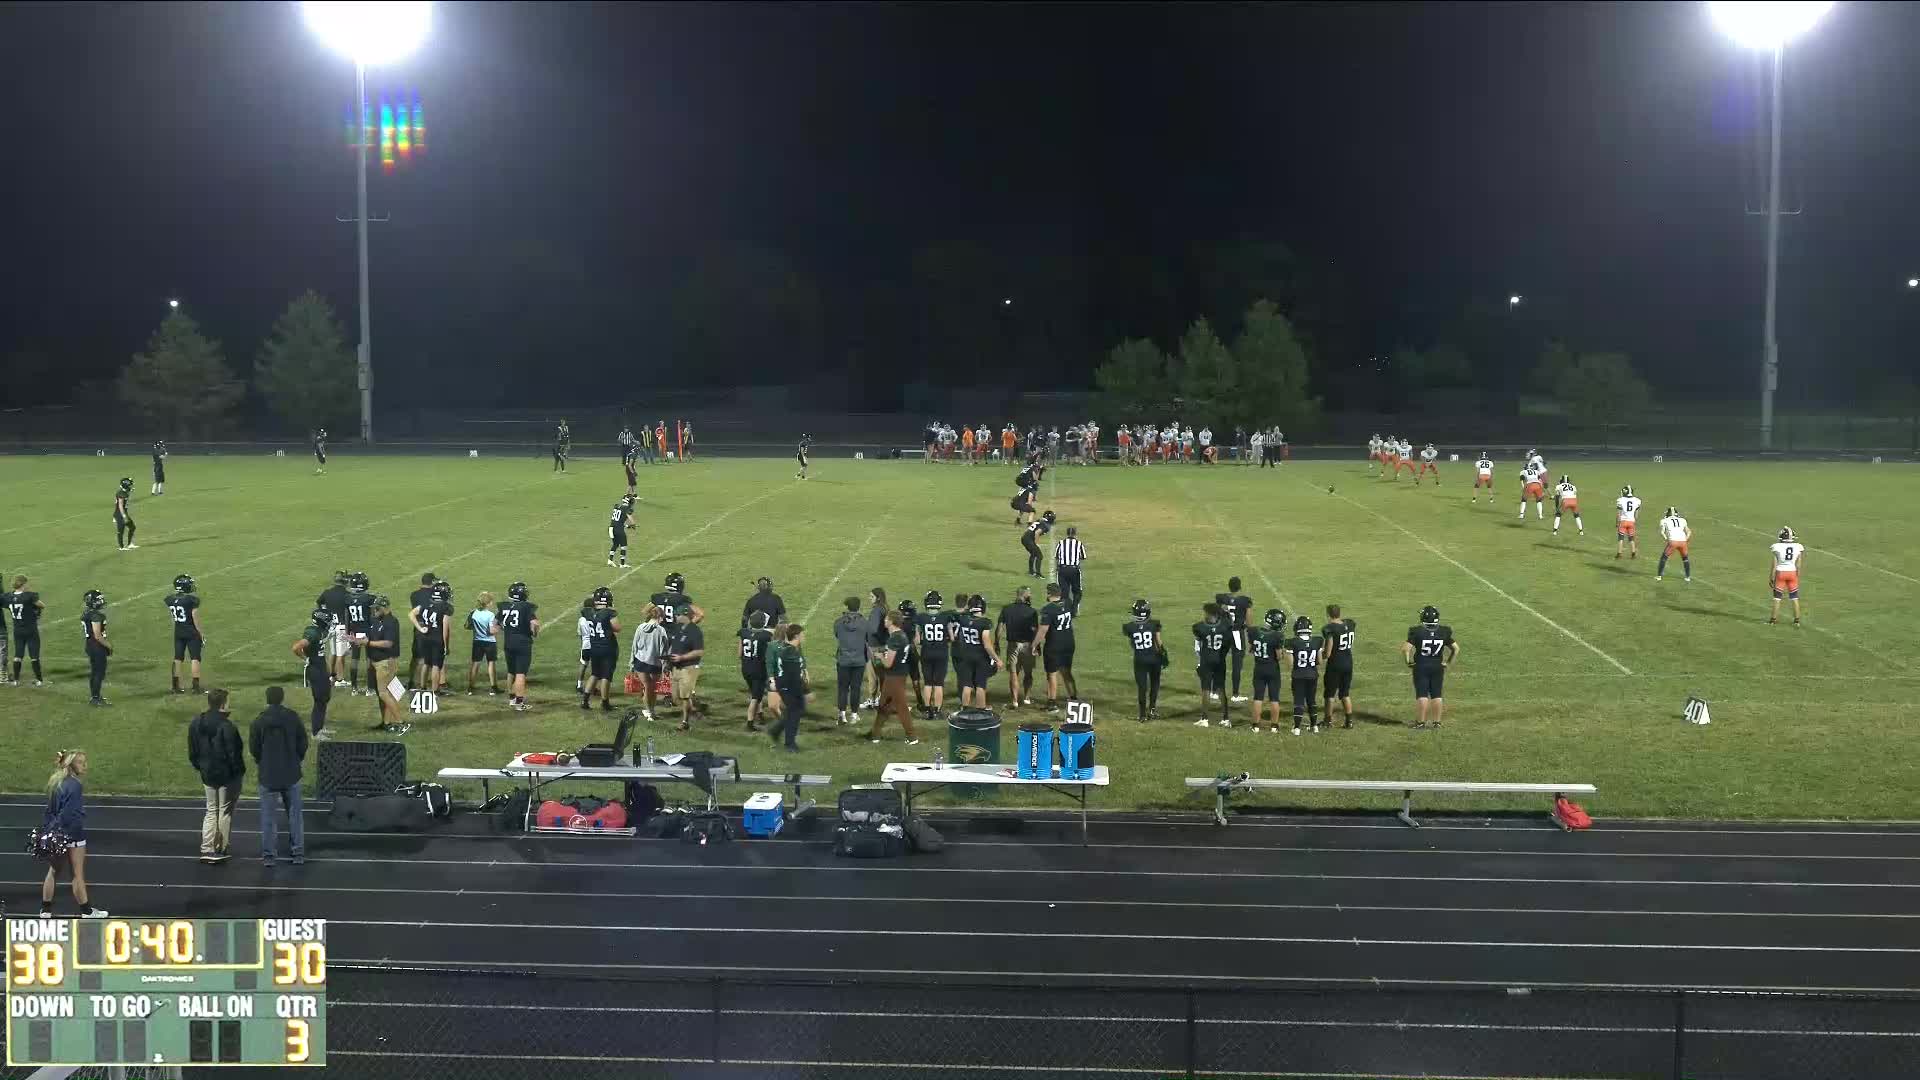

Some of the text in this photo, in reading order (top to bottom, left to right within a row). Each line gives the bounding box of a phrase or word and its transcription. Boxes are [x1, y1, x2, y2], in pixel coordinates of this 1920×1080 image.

[1626, 500, 1633, 512] 6
[1784, 547, 1794, 561] 8
[348, 605, 365, 622] 81
[422, 609, 438, 628] 44
[502, 609, 519, 628] 73
[1056, 611, 1072, 631] 77
[924, 623, 944, 642] 66
[961, 626, 981, 645] 52
[1133, 631, 1153, 650] 28
[1205, 633, 1223, 651] 16
[743, 638, 758, 657] 21
[1421, 639, 1444, 657] 57
[1297, 650, 1317, 668] 84
[410, 691, 433, 714] 40
[1684, 699, 1704, 724] 40
[1066, 701, 1091, 725] 50
